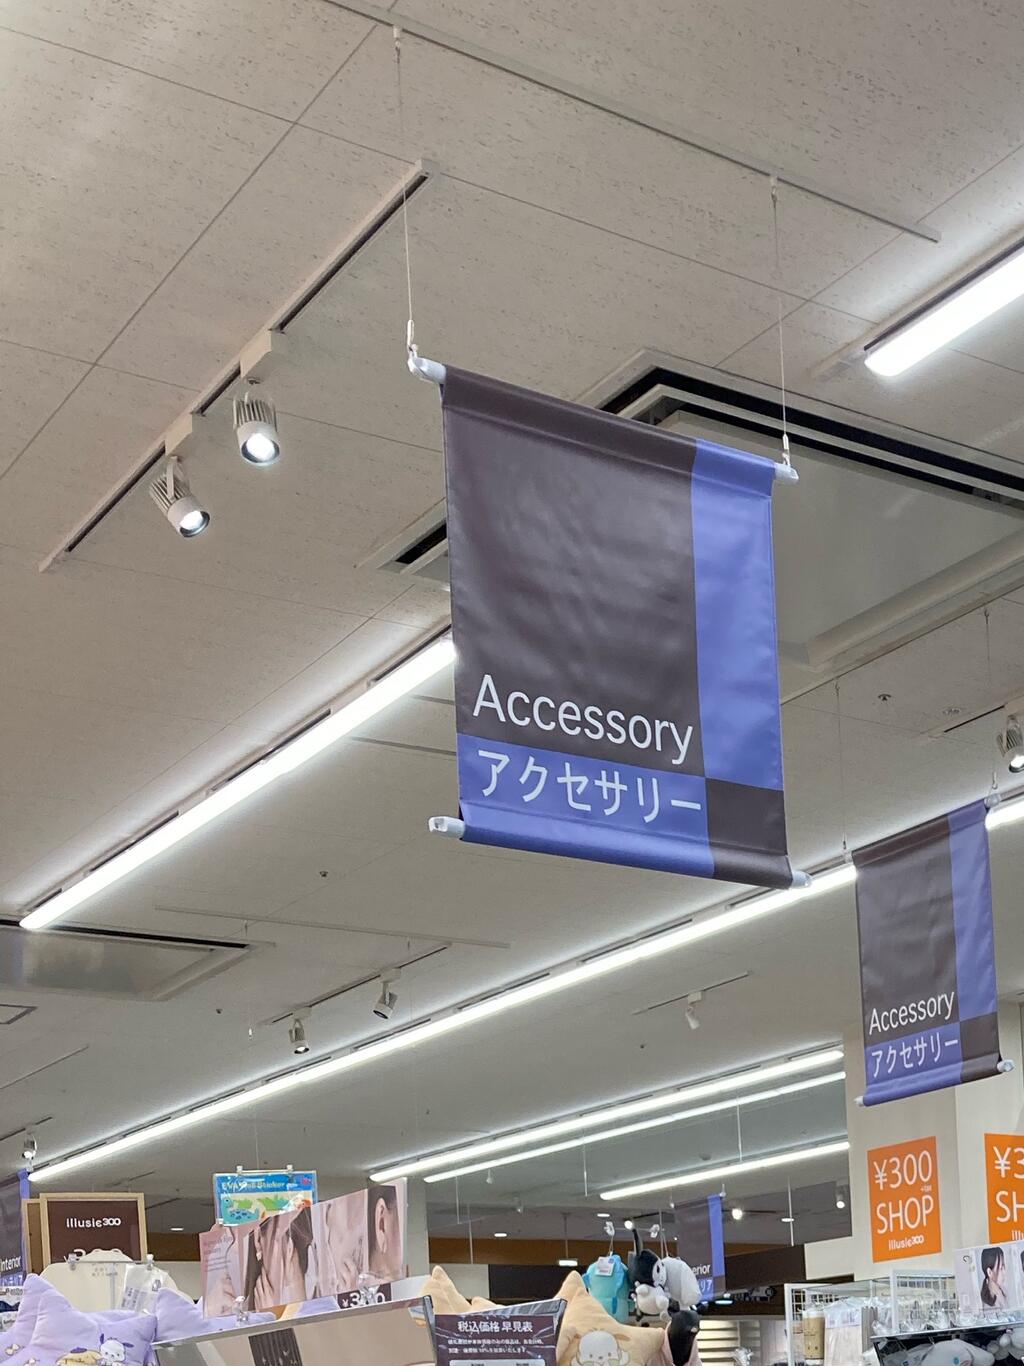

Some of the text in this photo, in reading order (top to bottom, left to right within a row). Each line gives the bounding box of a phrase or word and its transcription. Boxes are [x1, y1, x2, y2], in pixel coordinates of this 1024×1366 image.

[472, 674, 693, 765] Accessory
[478, 749, 701, 823] アクセサリー
[869, 991, 954, 1036] Accessory
[871, 1031, 959, 1078] アクセサリー
[873, 1150, 932, 1190] ¥300
[876, 1194, 934, 1235] SHOP
